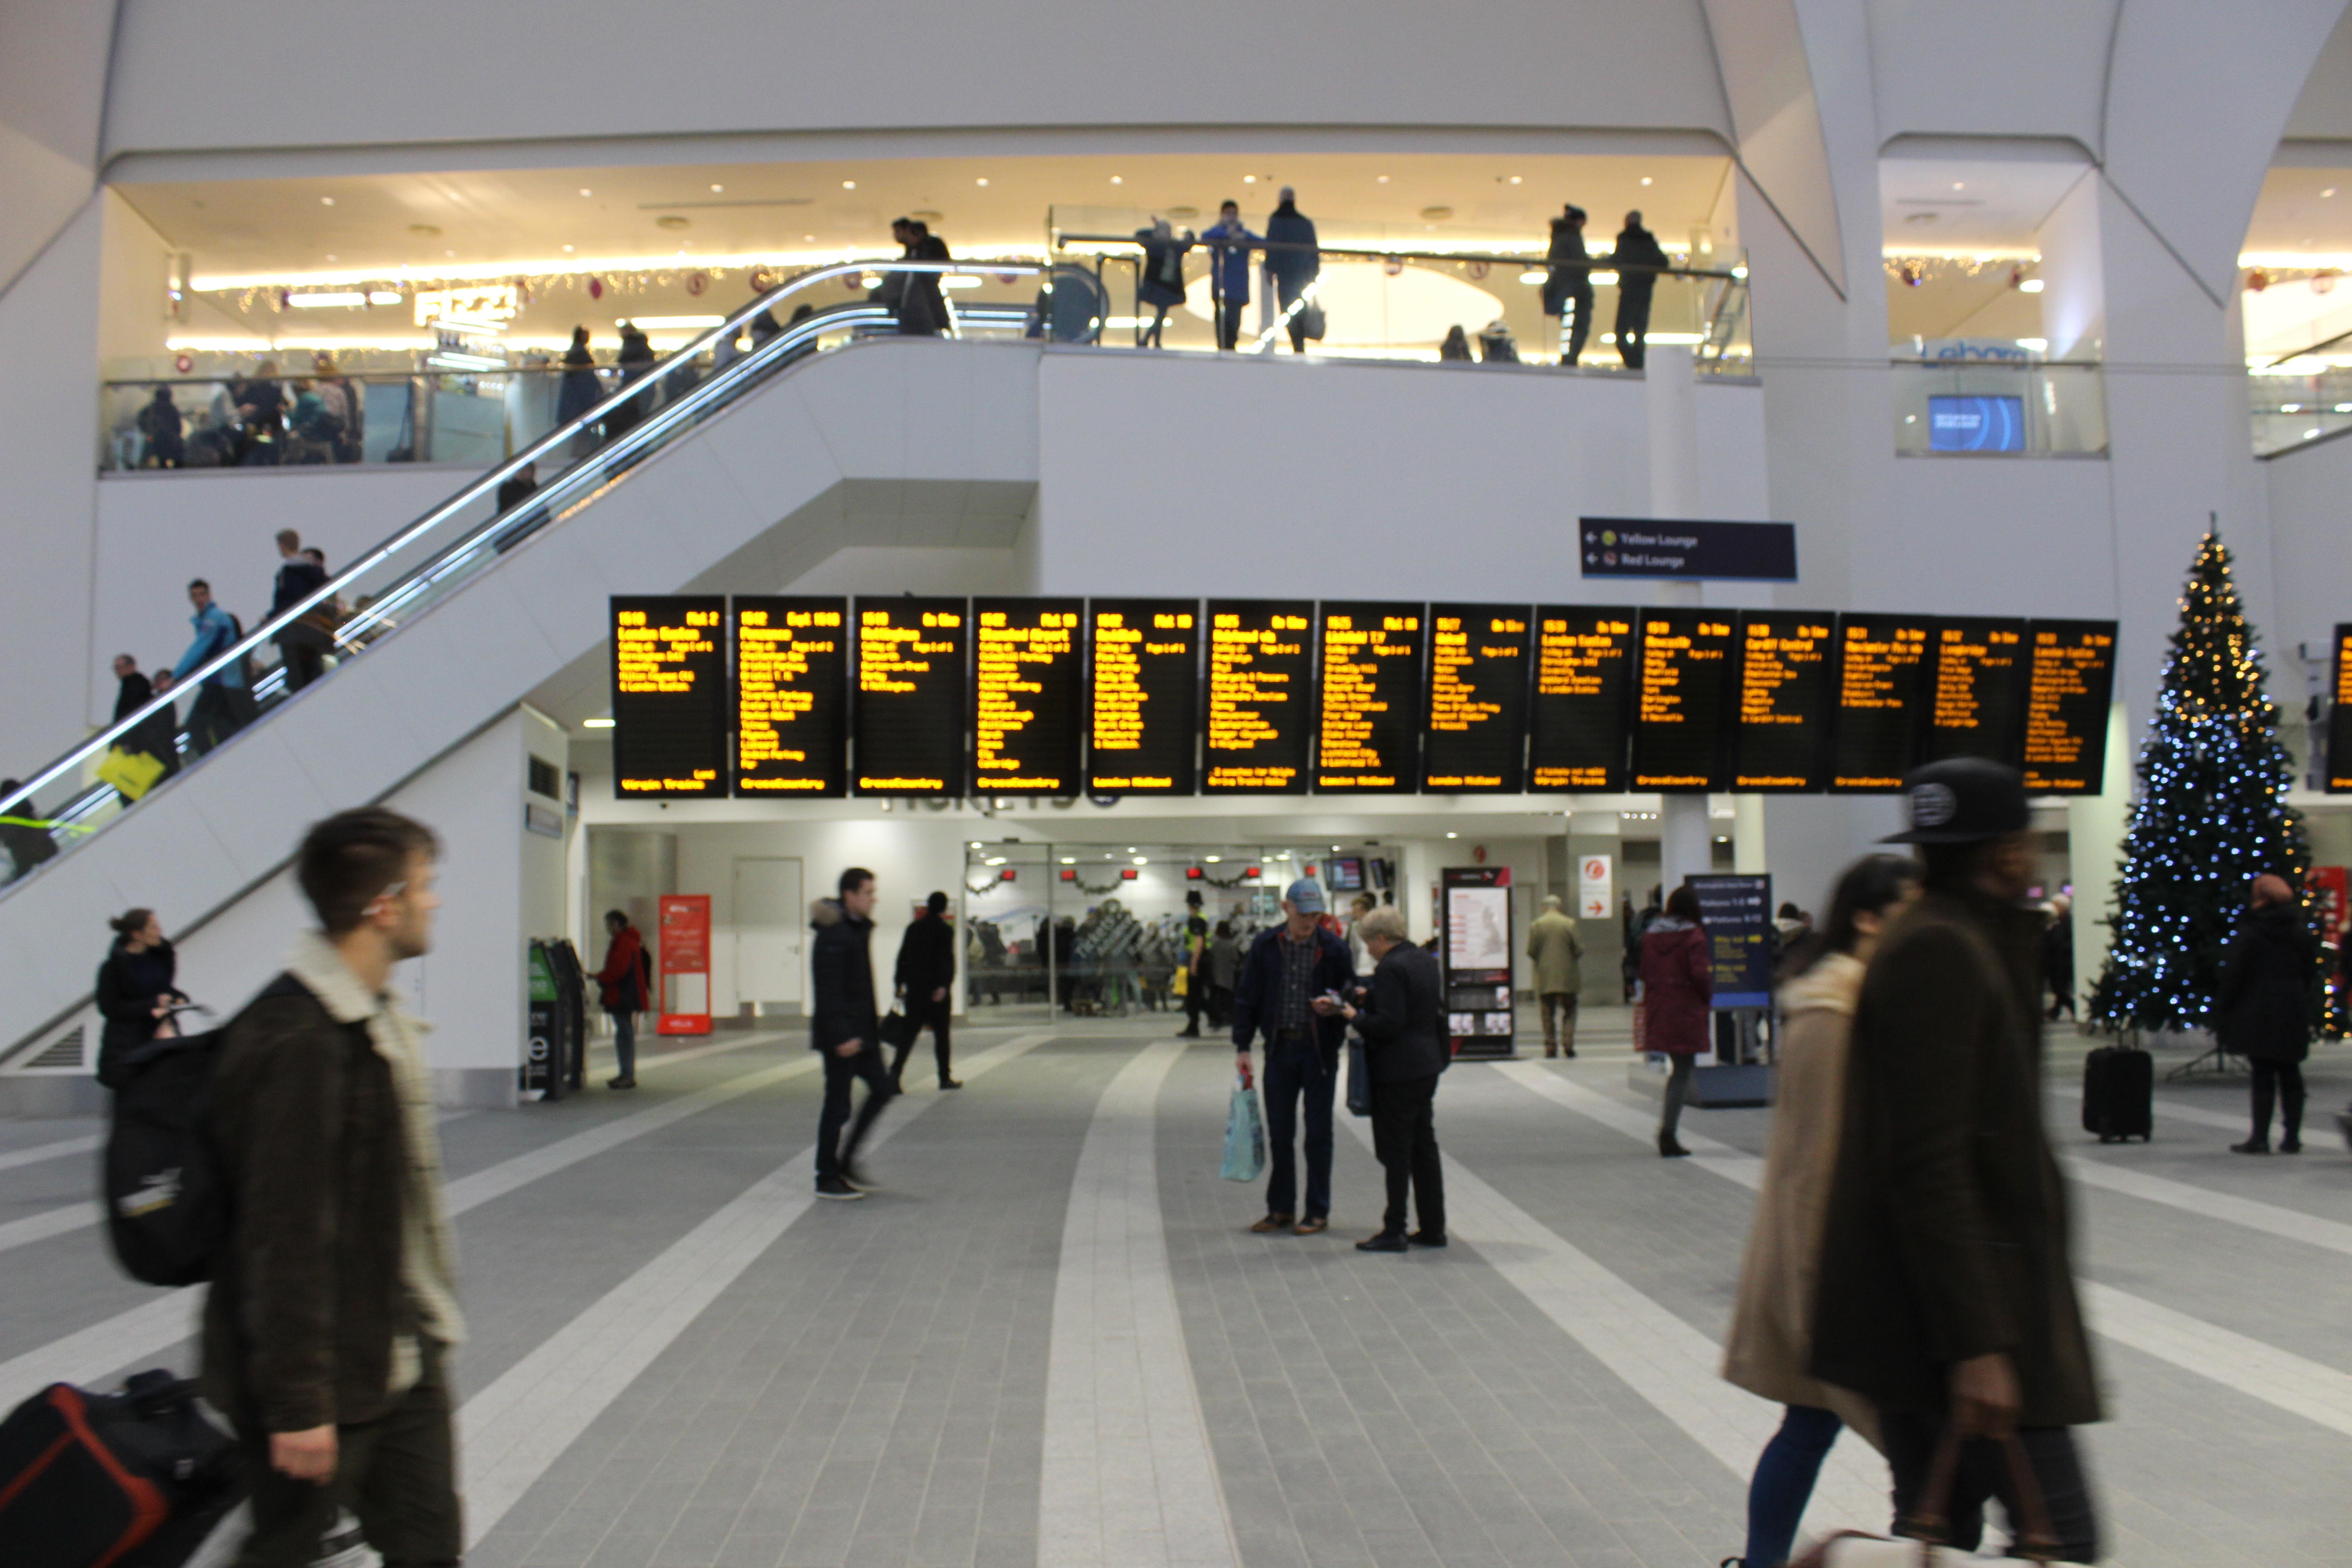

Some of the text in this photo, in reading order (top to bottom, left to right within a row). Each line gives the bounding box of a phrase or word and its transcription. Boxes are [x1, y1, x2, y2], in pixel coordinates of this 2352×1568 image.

[1621, 533, 1698, 549] Yellow Lounge
[1621, 553, 1685, 569] Red Lounge
